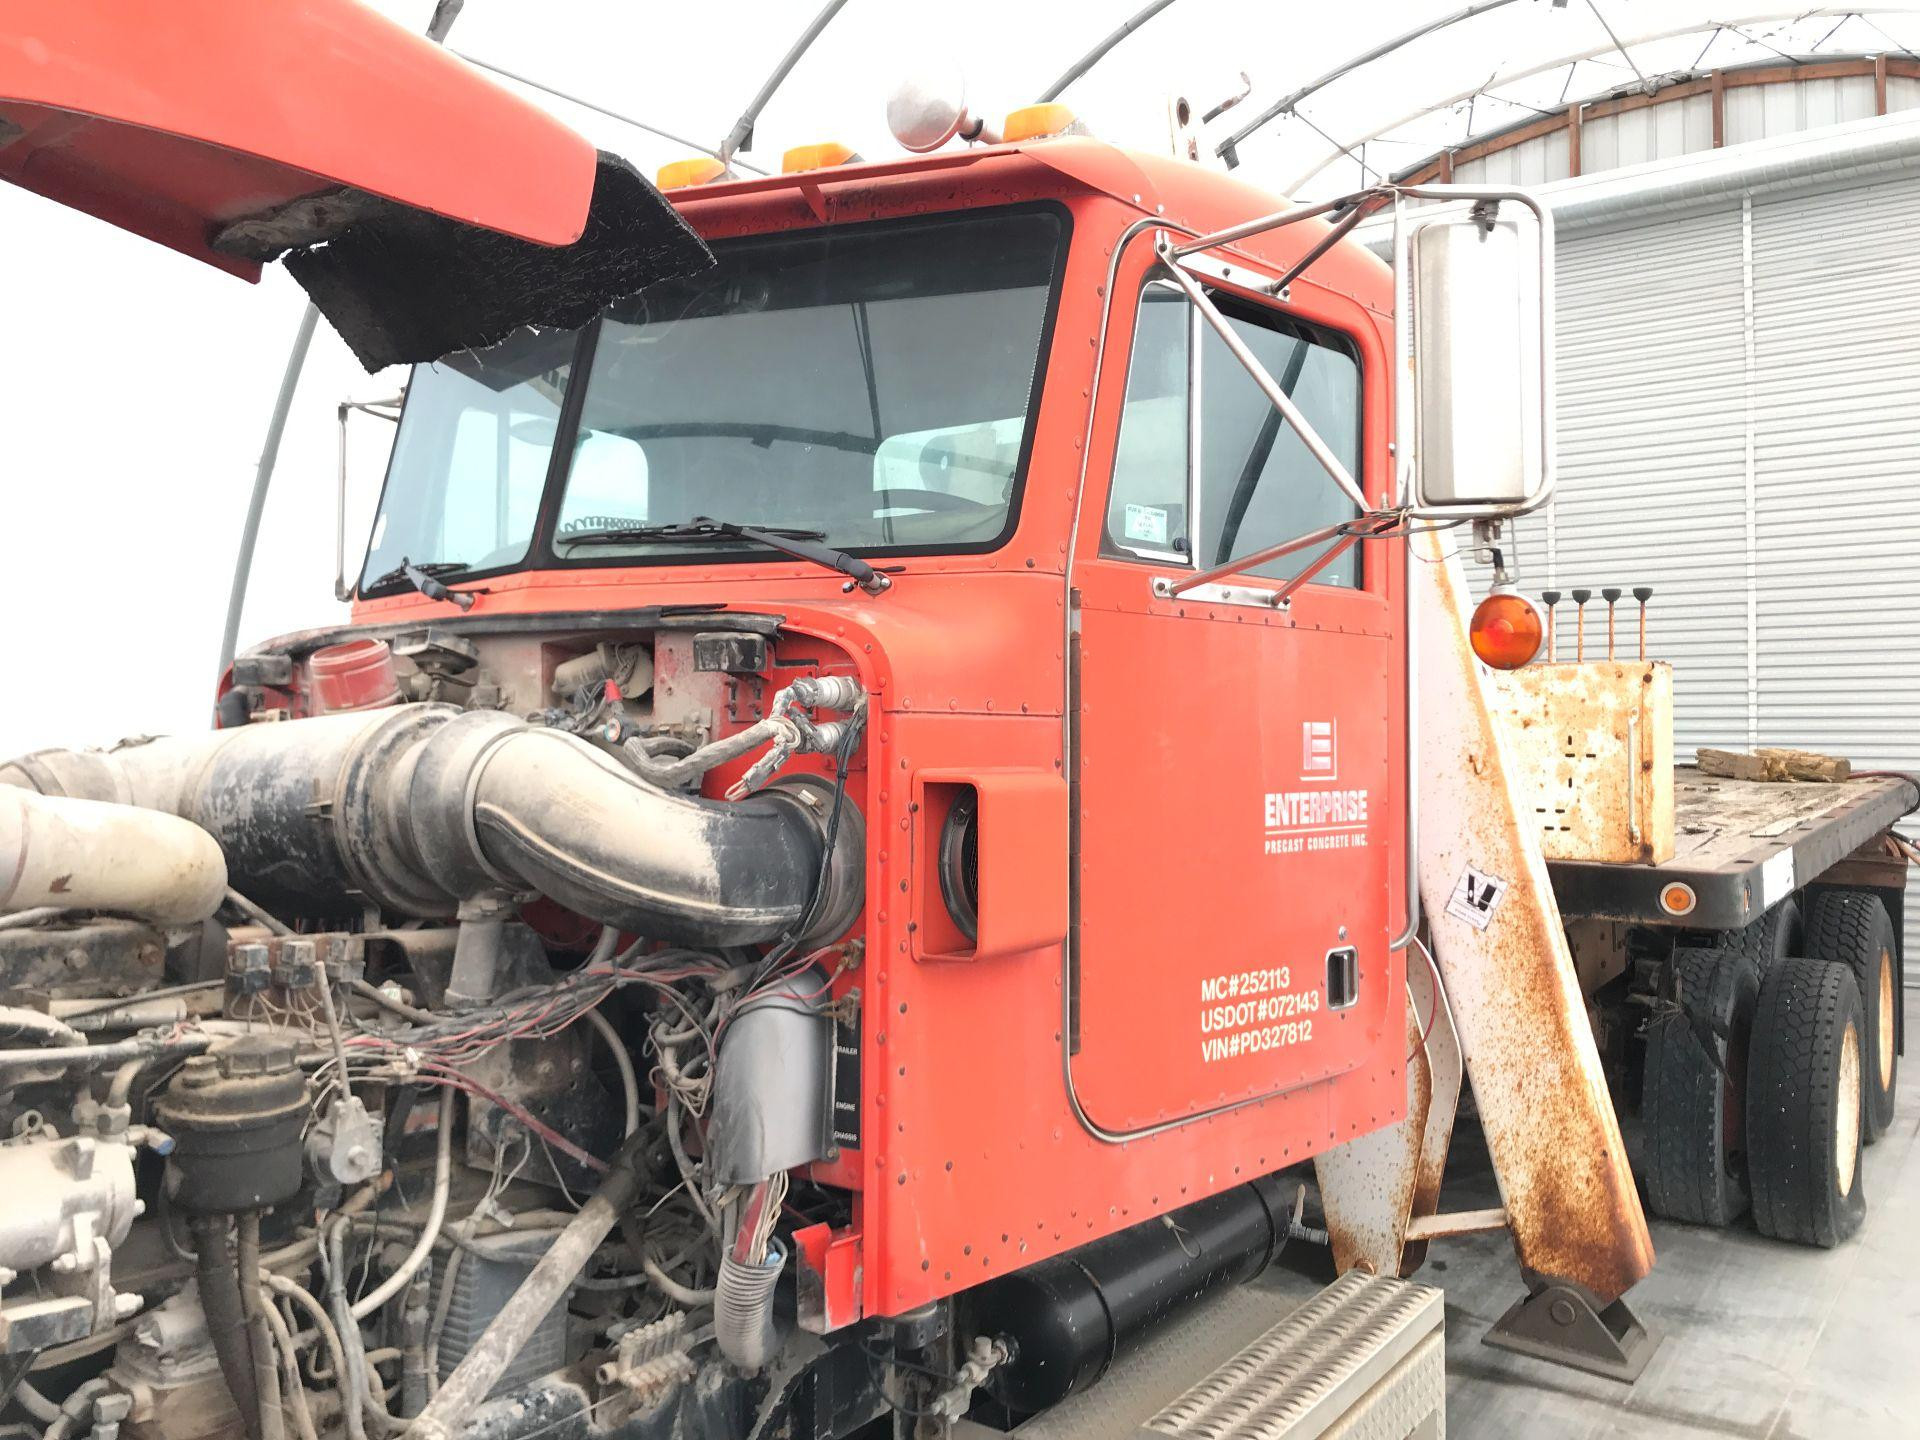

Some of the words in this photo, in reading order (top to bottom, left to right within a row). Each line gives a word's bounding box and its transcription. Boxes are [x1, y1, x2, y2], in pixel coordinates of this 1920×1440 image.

[1265, 790, 1368, 827] ENTERPRISE
[1265, 838, 1304, 855] PRECAST
[1307, 834, 1349, 850] CONCRETE
[1351, 833, 1368, 847] INC.
[1201, 966, 1290, 1002] MC#252113
[1201, 990, 1319, 1033] USDOT#072143
[1201, 1019, 1312, 1063] VIN#PD327812
[835, 1101, 856, 1112] ENGINE
